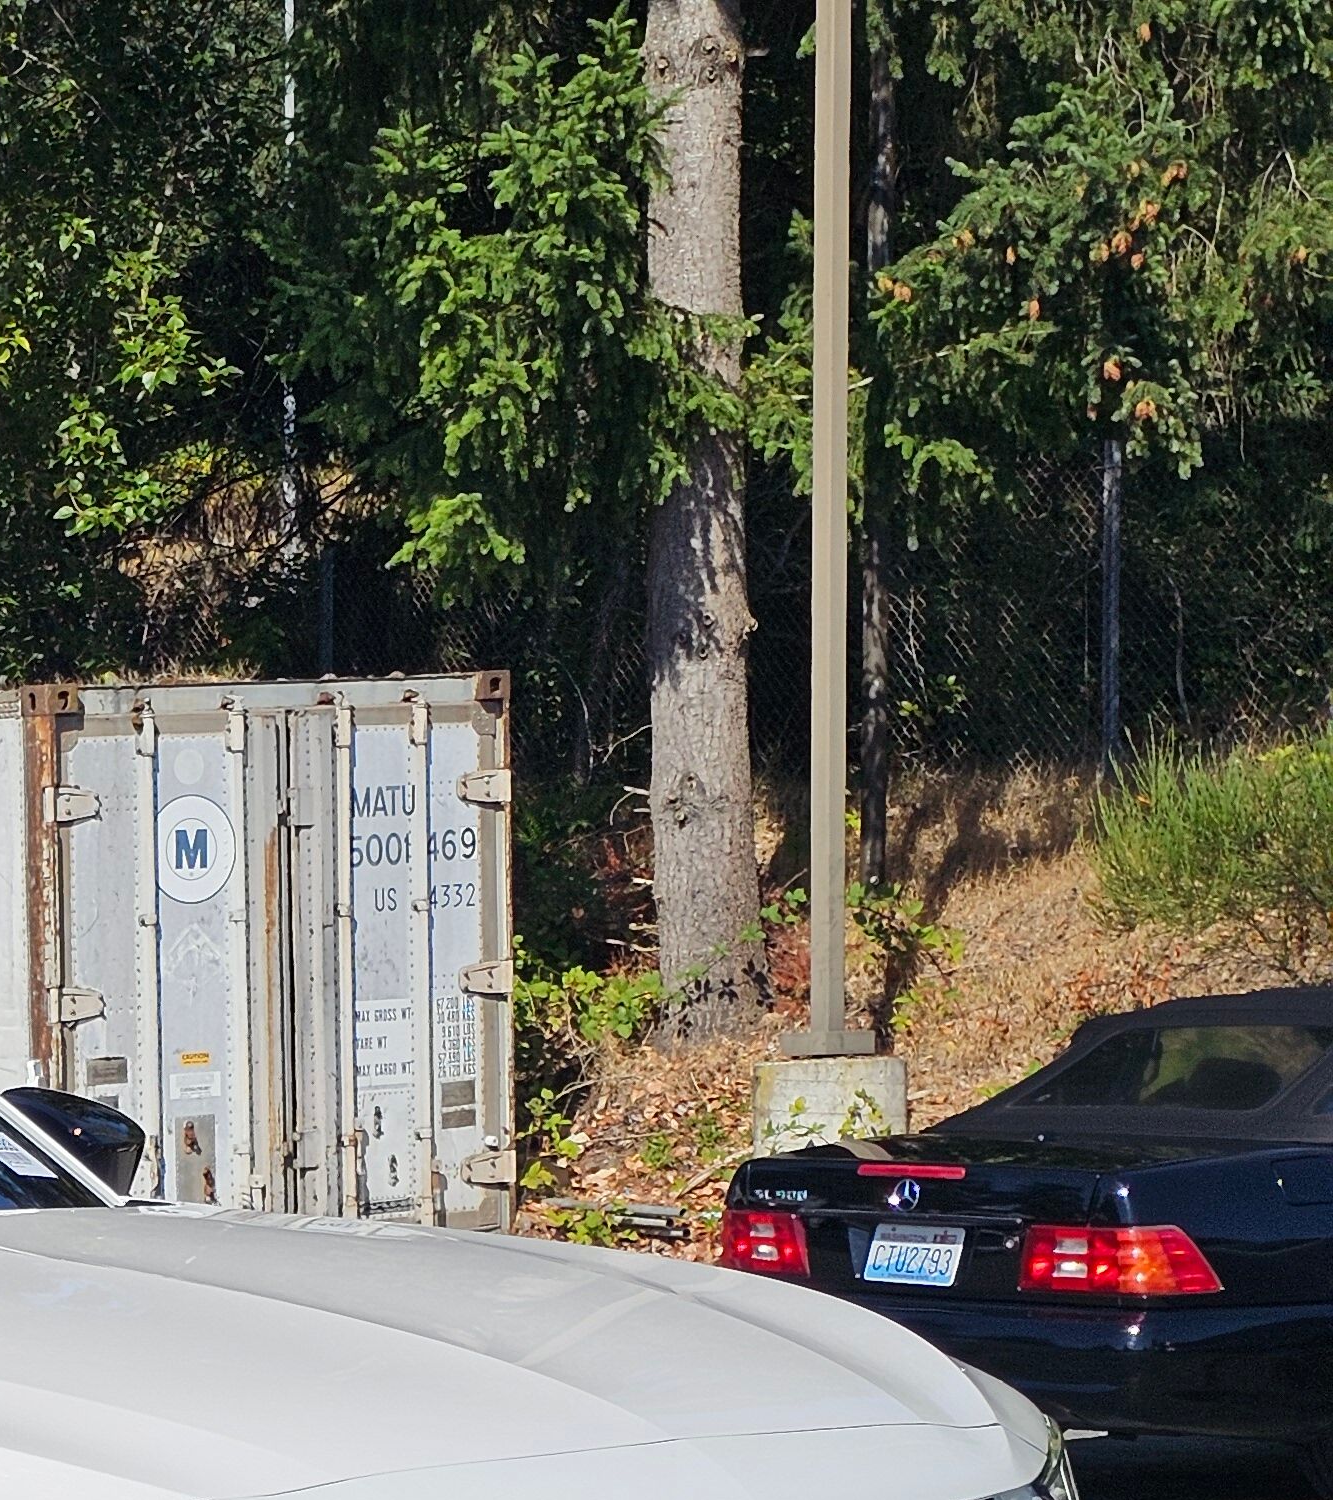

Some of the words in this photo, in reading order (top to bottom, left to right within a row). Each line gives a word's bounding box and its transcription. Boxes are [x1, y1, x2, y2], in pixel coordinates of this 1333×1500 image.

[352, 784, 416, 818] MATU
[175, 829, 207, 869] M
[374, 887, 398, 912] US
[429, 882, 476, 909] 4332
[374, 1008, 397, 1023] GROSS
[401, 1007, 412, 1021] WT
[377, 1036, 388, 1049] WT
[374, 1062, 397, 1077] CARGO
[401, 1061, 413, 1075] WT
[872, 1244, 953, 1276] CTU2793
